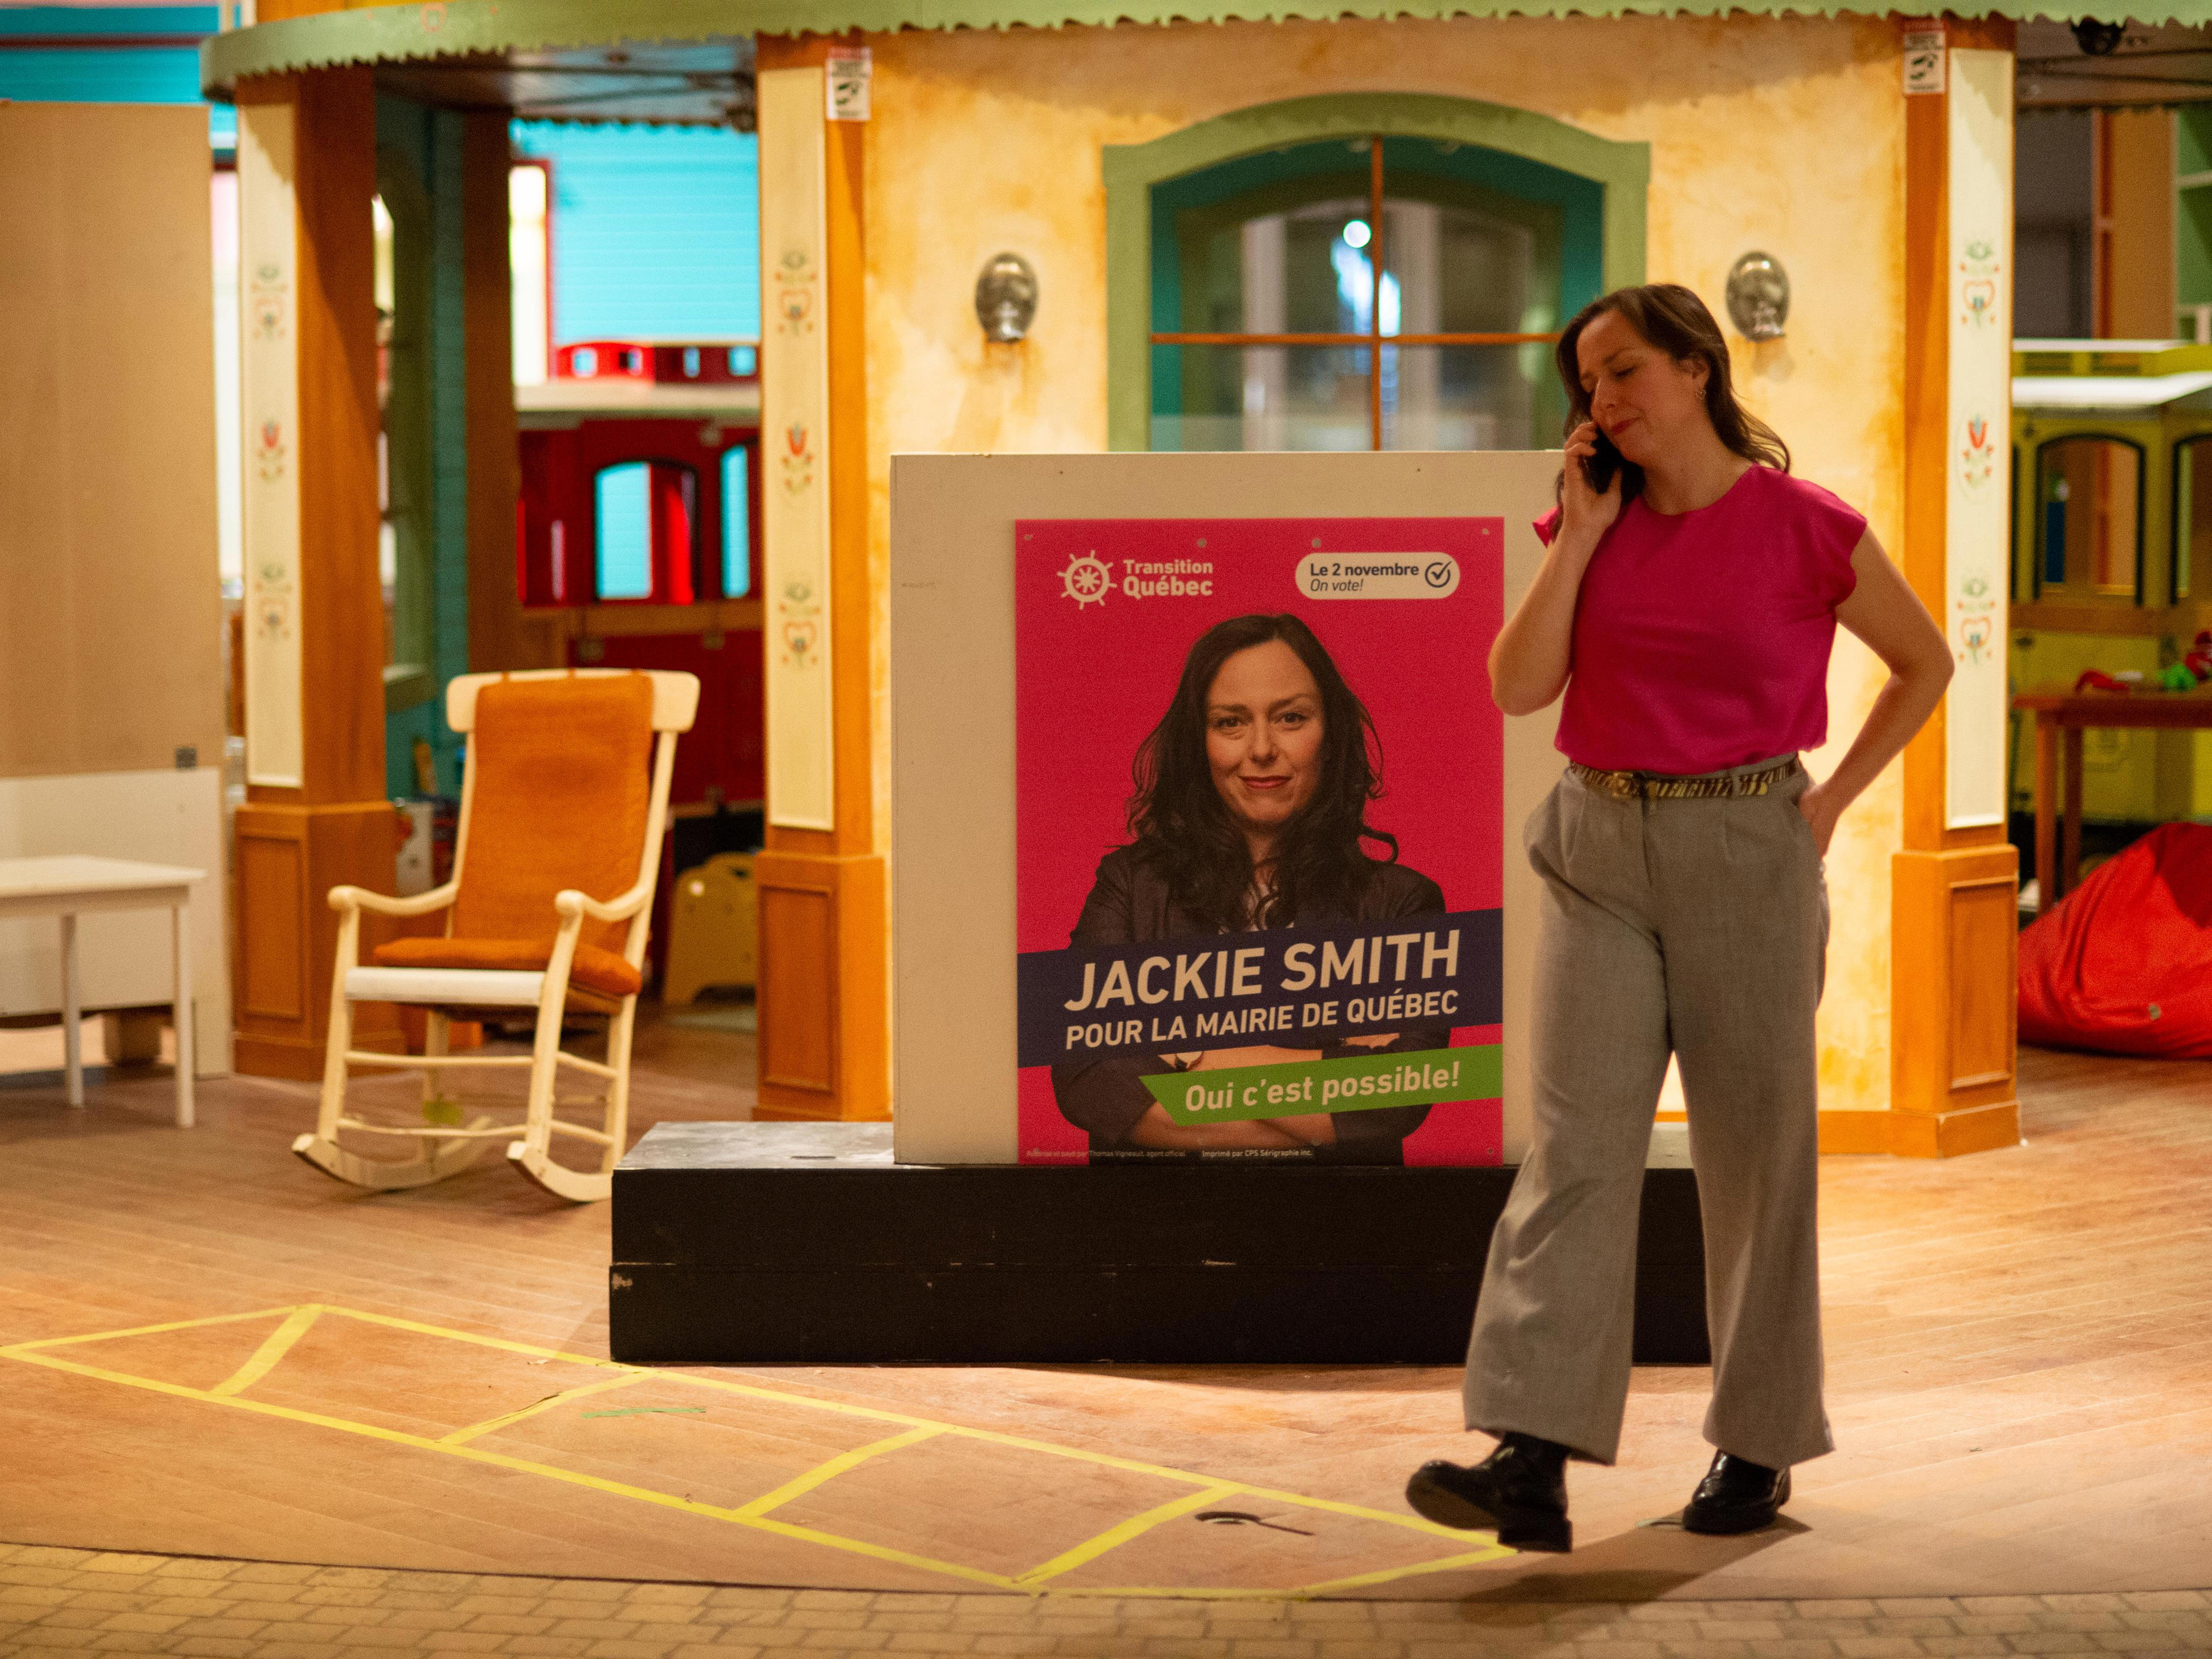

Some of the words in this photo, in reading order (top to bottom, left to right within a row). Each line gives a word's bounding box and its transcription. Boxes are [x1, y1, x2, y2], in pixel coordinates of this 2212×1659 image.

[1123, 559, 1213, 574] Transition
[1311, 563, 1328, 576] Le
[1332, 563, 1341, 576] 2
[1345, 563, 1419, 576] novembre
[1123, 575, 1213, 599] Québec
[1311, 578, 1327, 592] On
[1332, 578, 1364, 592] vote!
[1064, 947, 1266, 1011] JACKIE
[1280, 929, 1460, 991] SMITH
[1066, 1019, 1143, 1050] POUR
[1151, 1015, 1187, 1042] LA
[1196, 1005, 1294, 1038] MAIRIE
[1302, 1000, 1339, 1028] DE
[1346, 988, 1459, 1024] QUÉBEC
[1185, 1082, 1234, 1111] Oui
[1243, 1076, 1313, 1106] c'est
[1322, 1061, 1460, 1106] possible!
[1202, 1150, 1230, 1158] Imprimé
[1260, 1149, 1299, 1158] Sérigraphie
